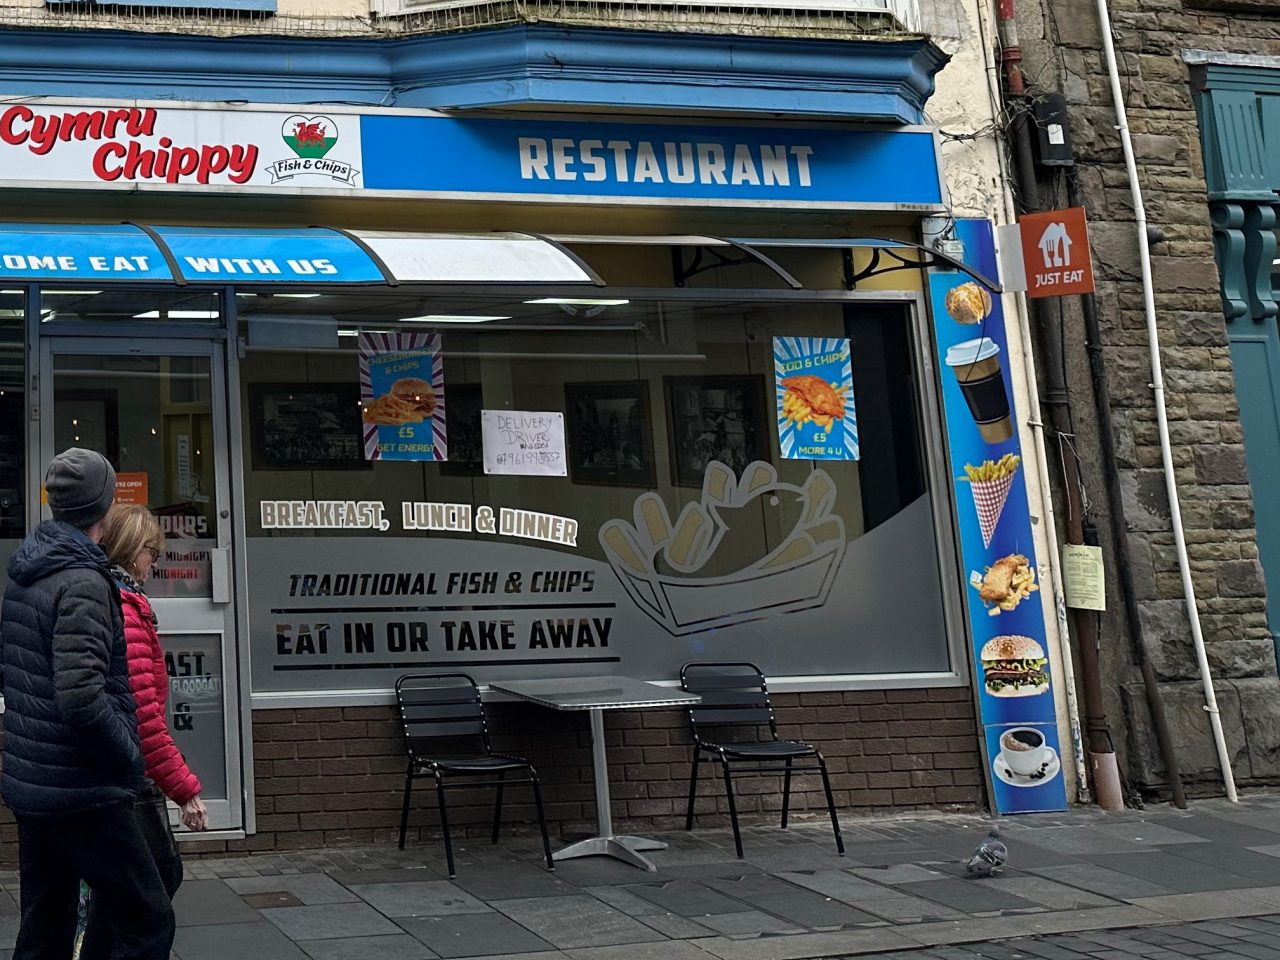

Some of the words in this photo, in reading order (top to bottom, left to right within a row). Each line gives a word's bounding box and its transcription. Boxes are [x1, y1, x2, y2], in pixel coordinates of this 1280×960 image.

[92, 137, 258, 184] Chippy
[278, 161, 301, 172] Fish
[303, 160, 313, 169] &
[314, 160, 348, 174] Chips
[518, 136, 814, 189] RESTAURANT
[90, 255, 150, 272] EAT
[183, 256, 283, 274] WITH
[287, 258, 338, 275] US
[1035, 272, 1061, 288] JUST
[1063, 269, 1084, 284] EAT
[385, 366, 392, 375] &
[393, 360, 420, 373] CHIPS
[804, 358, 812, 368] &
[813, 351, 846, 366] CHIPS
[398, 426, 415, 438] £5
[497, 415, 552, 432] DELIVERY
[501, 430, 550, 445] DRIVER
[813, 432, 827, 442] £5
[376, 443, 395, 452] GET
[398, 443, 436, 453] ENERGY
[798, 446, 826, 455] MORE
[827, 446, 833, 455] 4
[835, 446, 842, 455] U
[260, 501, 390, 531] BREAKFAST,
[402, 501, 471, 532] LUNCH
[476, 506, 496, 534] &
[499, 507, 578, 547] DINNER
[165, 551, 212, 562] MIDNIGHT
[152, 568, 199, 579] MIDNIGHT
[289, 572, 438, 597] TRADITIONAL
[446, 572, 498, 594] FISH
[504, 571, 522, 593] &
[530, 570, 595, 593] CHIPS
[276, 623, 331, 655] EAT
[343, 622, 374, 653] IN
[386, 622, 430, 652] OR
[440, 619, 517, 651] TAKE
[528, 617, 613, 649] AWAY
[174, 702, 194, 730] &
